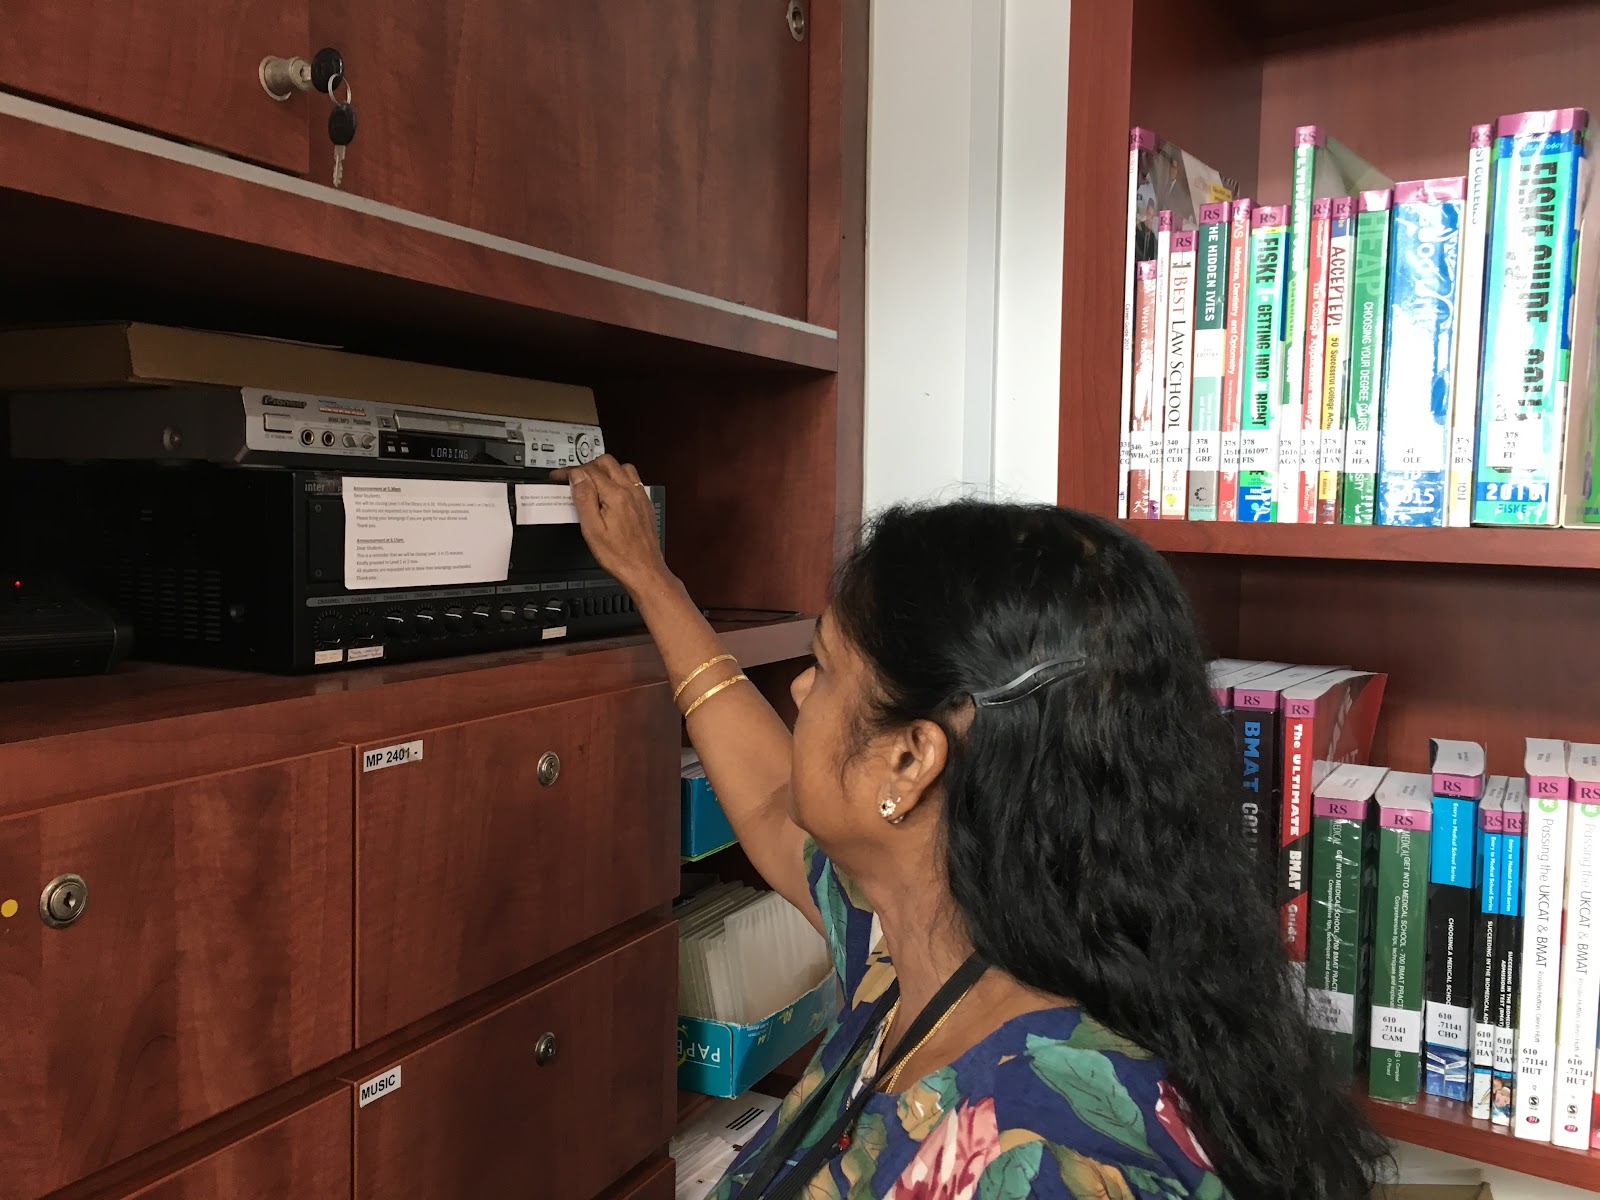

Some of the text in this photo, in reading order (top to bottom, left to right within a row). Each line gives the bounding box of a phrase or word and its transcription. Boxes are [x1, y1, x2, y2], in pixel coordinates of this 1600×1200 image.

[1203, 208, 1221, 221] RS
[1259, 212, 1278, 225] RS
[1176, 237, 1192, 249] RS
[1256, 237, 1279, 284] FISKE
[1356, 214, 1387, 297] HEAP
[1204, 223, 1219, 322] HE HIDDEN IVIES
[1327, 246, 1347, 327] ACCEPTED!
[1227, 246, 1243, 375] Medicine, Dentistry and Optometry
[1361, 301, 1374, 345] CHOOSING
[1254, 303, 1273, 380] GETTING INTO
[1330, 337, 1340, 348] 50
[1168, 278, 1188, 430] BEST LAW SCHOOL
[1360, 345, 1372, 368] YOUR
[1358, 369, 1370, 401] DEGREE
[1504, 431, 1519, 439] 378
[430, 447, 469, 460] LOADING
[1498, 503, 1527, 514] FISKE
[1244, 695, 1261, 707] RS
[1292, 704, 1310, 716] RS
[1293, 723, 1304, 749] The
[366, 747, 410, 768] MP 2401
[1242, 720, 1261, 793] BMAT
[1443, 780, 1462, 792] RS
[1538, 781, 1558, 794] RS
[1580, 787, 1600, 800] RS
[1290, 753, 1302, 837] ULTIMATE
[1329, 803, 1348, 816] RS
[1452, 802, 1460, 817] Entry
[1395, 813, 1414, 829] RS
[1485, 815, 1504, 827] RS
[1451, 826, 1459, 846] Medical
[1507, 838, 1515, 852] Entry
[1403, 857, 1411, 871] GET
[1450, 847, 1458, 865] School
[1288, 849, 1302, 890] BMAT
[1487, 837, 1498, 912] Entry Medical School Series
[1402, 872, 1410, 889] INTO
[1580, 869, 1593, 888] the
[1334, 880, 1342, 907] MEDICAL
[1535, 818, 1554, 968] Passing the UKCAT & BMAT
[1401, 889, 1409, 919] MEDICAL
[1578, 890, 1592, 928] UKCAT
[1333, 907, 1341, 934] SCHOOL
[1393, 895, 1401, 935] Comprehensive
[1399, 919, 1408, 948] SCHOOL
[1447, 917, 1455, 950] CHOOSING
[1486, 920, 1494, 957] SUCCEEDING
[1575, 943, 1589, 974] BMAT
[1506, 951, 1514, 985] SUCCEEDING
[1438, 1012, 1452, 1020] 610
[1382, 1025, 1406, 1034] .71141
[1437, 1030, 1458, 1040] CHO
[1438, 1021, 1462, 1032] .71141
[1477, 1030, 1491, 1038] 610
[1381, 1034, 1403, 1043] CAM
[1497, 1037, 1511, 1045] 610
[1522, 1047, 1538, 1056] 610
[1522, 1057, 1548, 1067] .71141
[1567, 1057, 1582, 1066] 610
[1522, 1066, 1542, 1076] HUT
[361, 1074, 395, 1101] MUSIC
[1566, 1076, 1588, 1086] HUT
